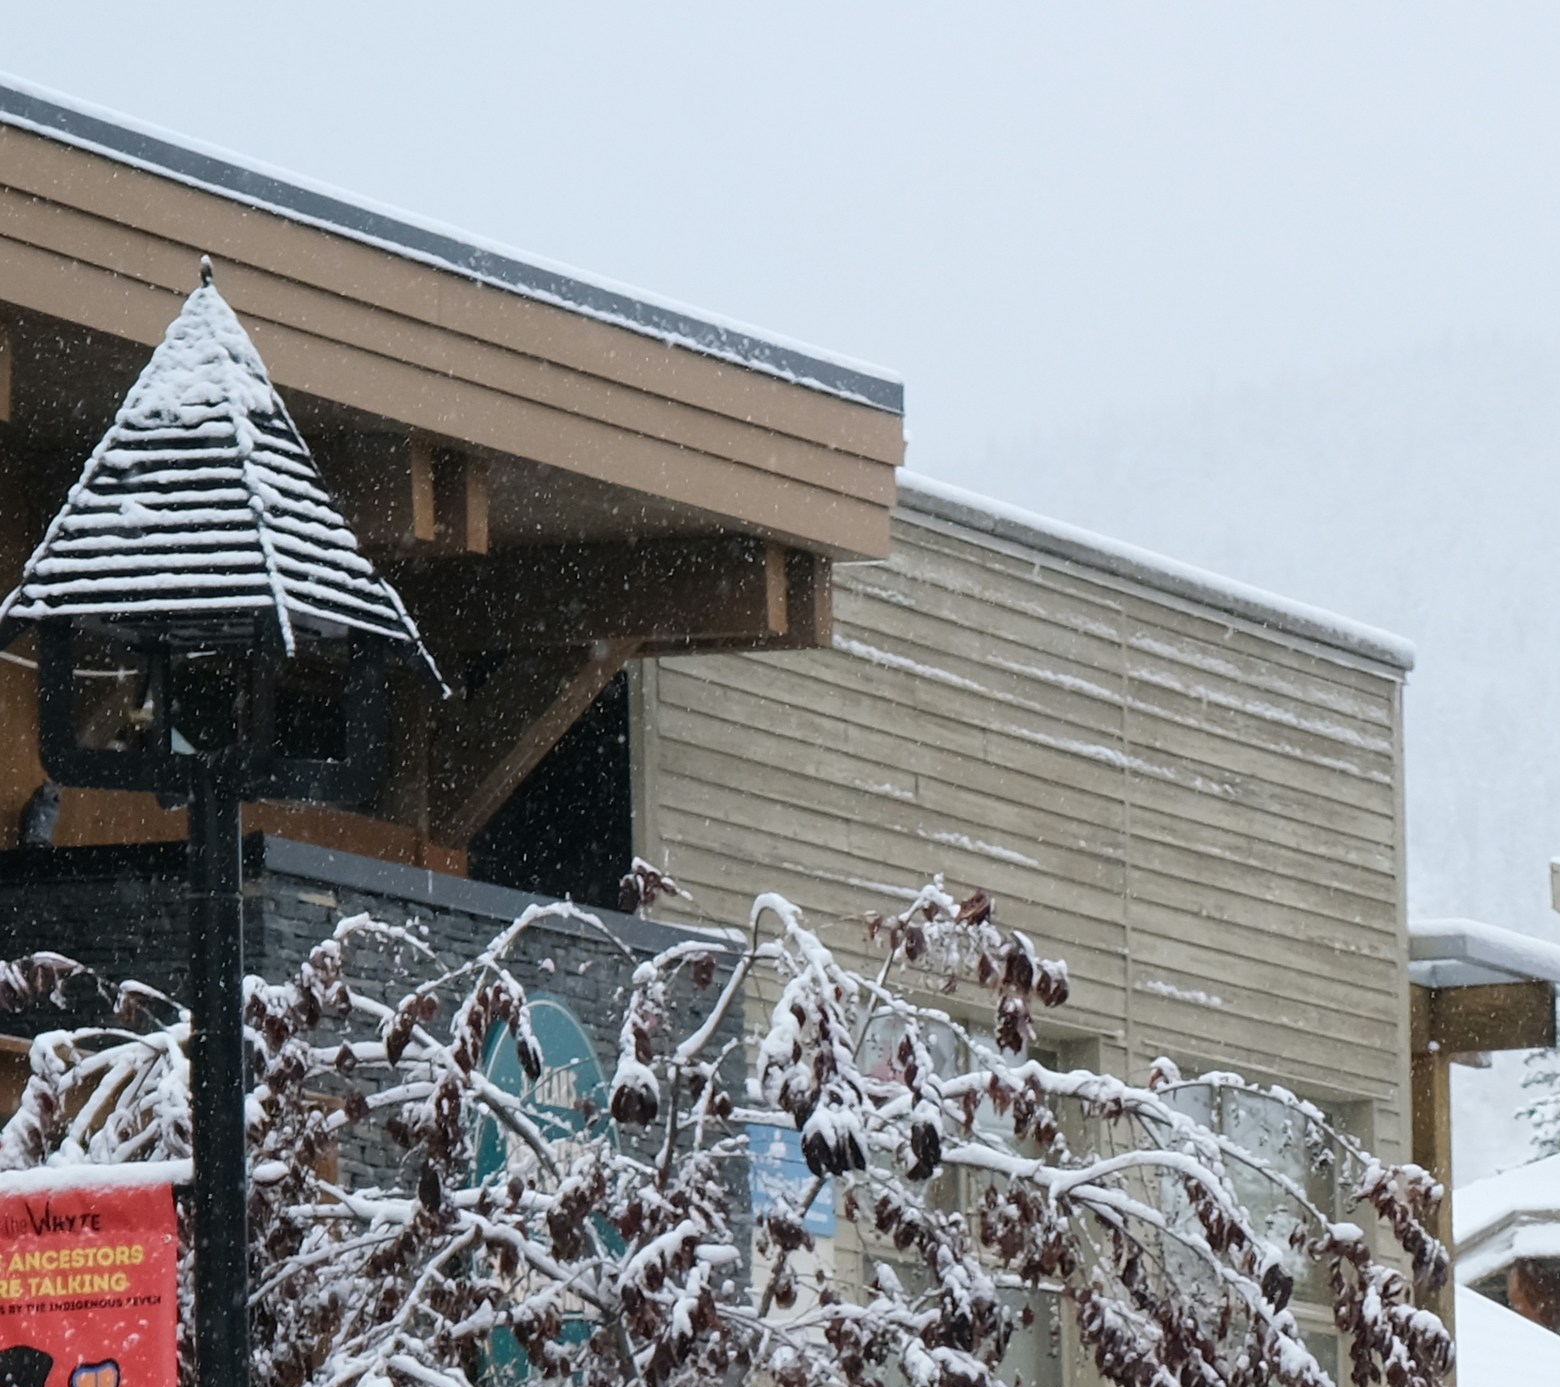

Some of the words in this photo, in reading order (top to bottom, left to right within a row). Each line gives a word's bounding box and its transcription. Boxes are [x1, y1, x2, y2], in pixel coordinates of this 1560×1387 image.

[8, 1244, 144, 1272] ANCESTORS
[0, 1278, 23, 1299] RE
[28, 1271, 130, 1298] TALKING
[8, 1303, 22, 1315] BY
[50, 1297, 122, 1312] INDIGENOUS
